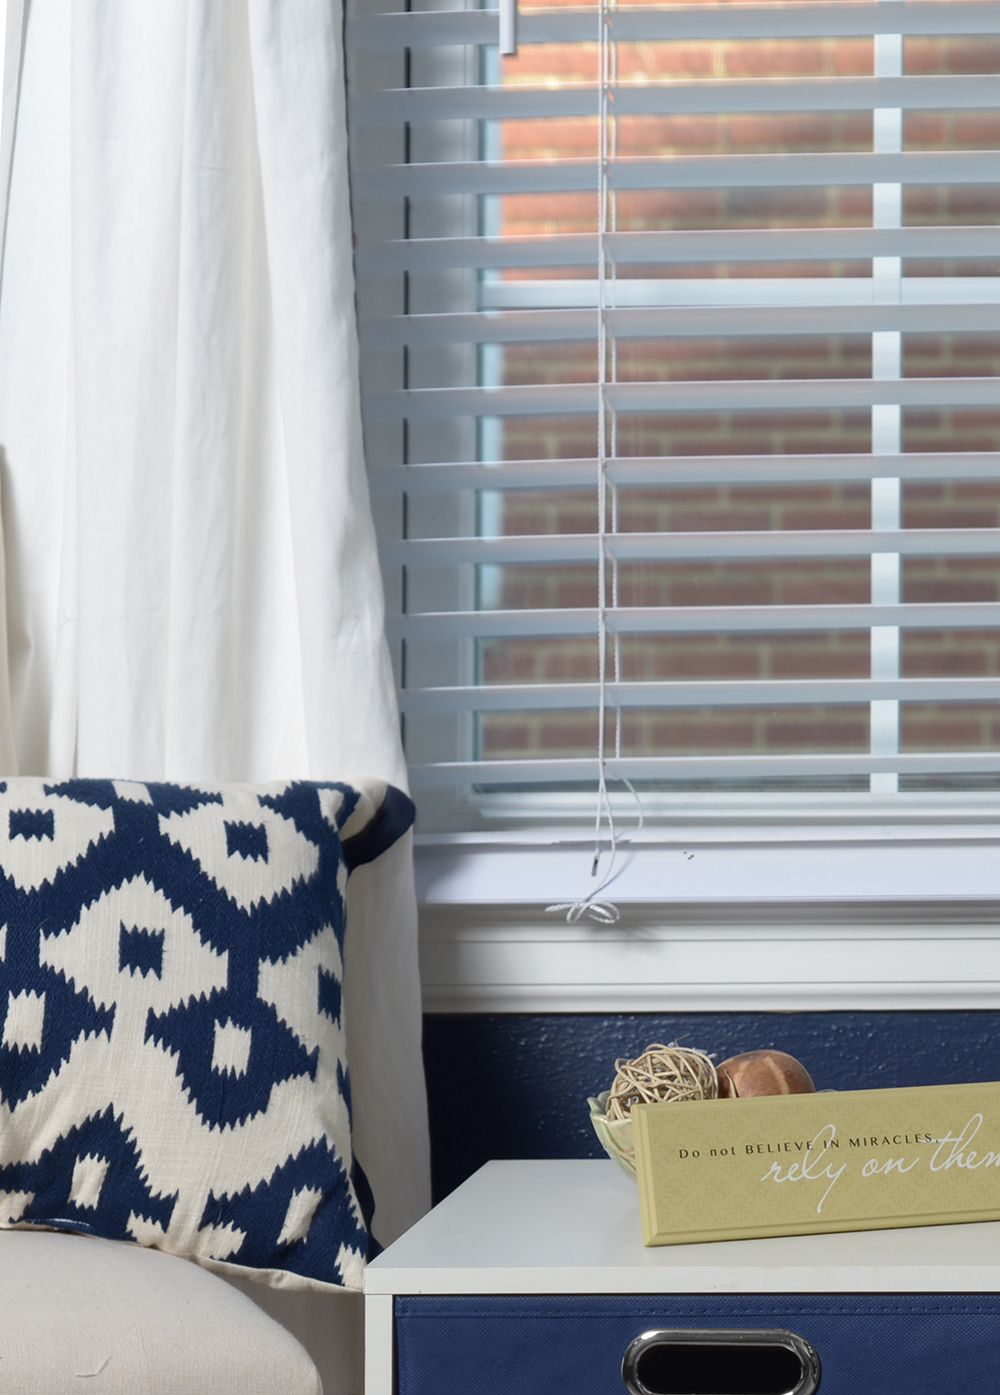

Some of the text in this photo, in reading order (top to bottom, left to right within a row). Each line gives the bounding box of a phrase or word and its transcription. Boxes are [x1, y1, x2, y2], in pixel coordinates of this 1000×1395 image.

[679, 1132, 940, 1159] Do not BELIEVE IN MIRACLES,
[760, 1123, 848, 1213] rely
[861, 1152, 920, 1178] on
